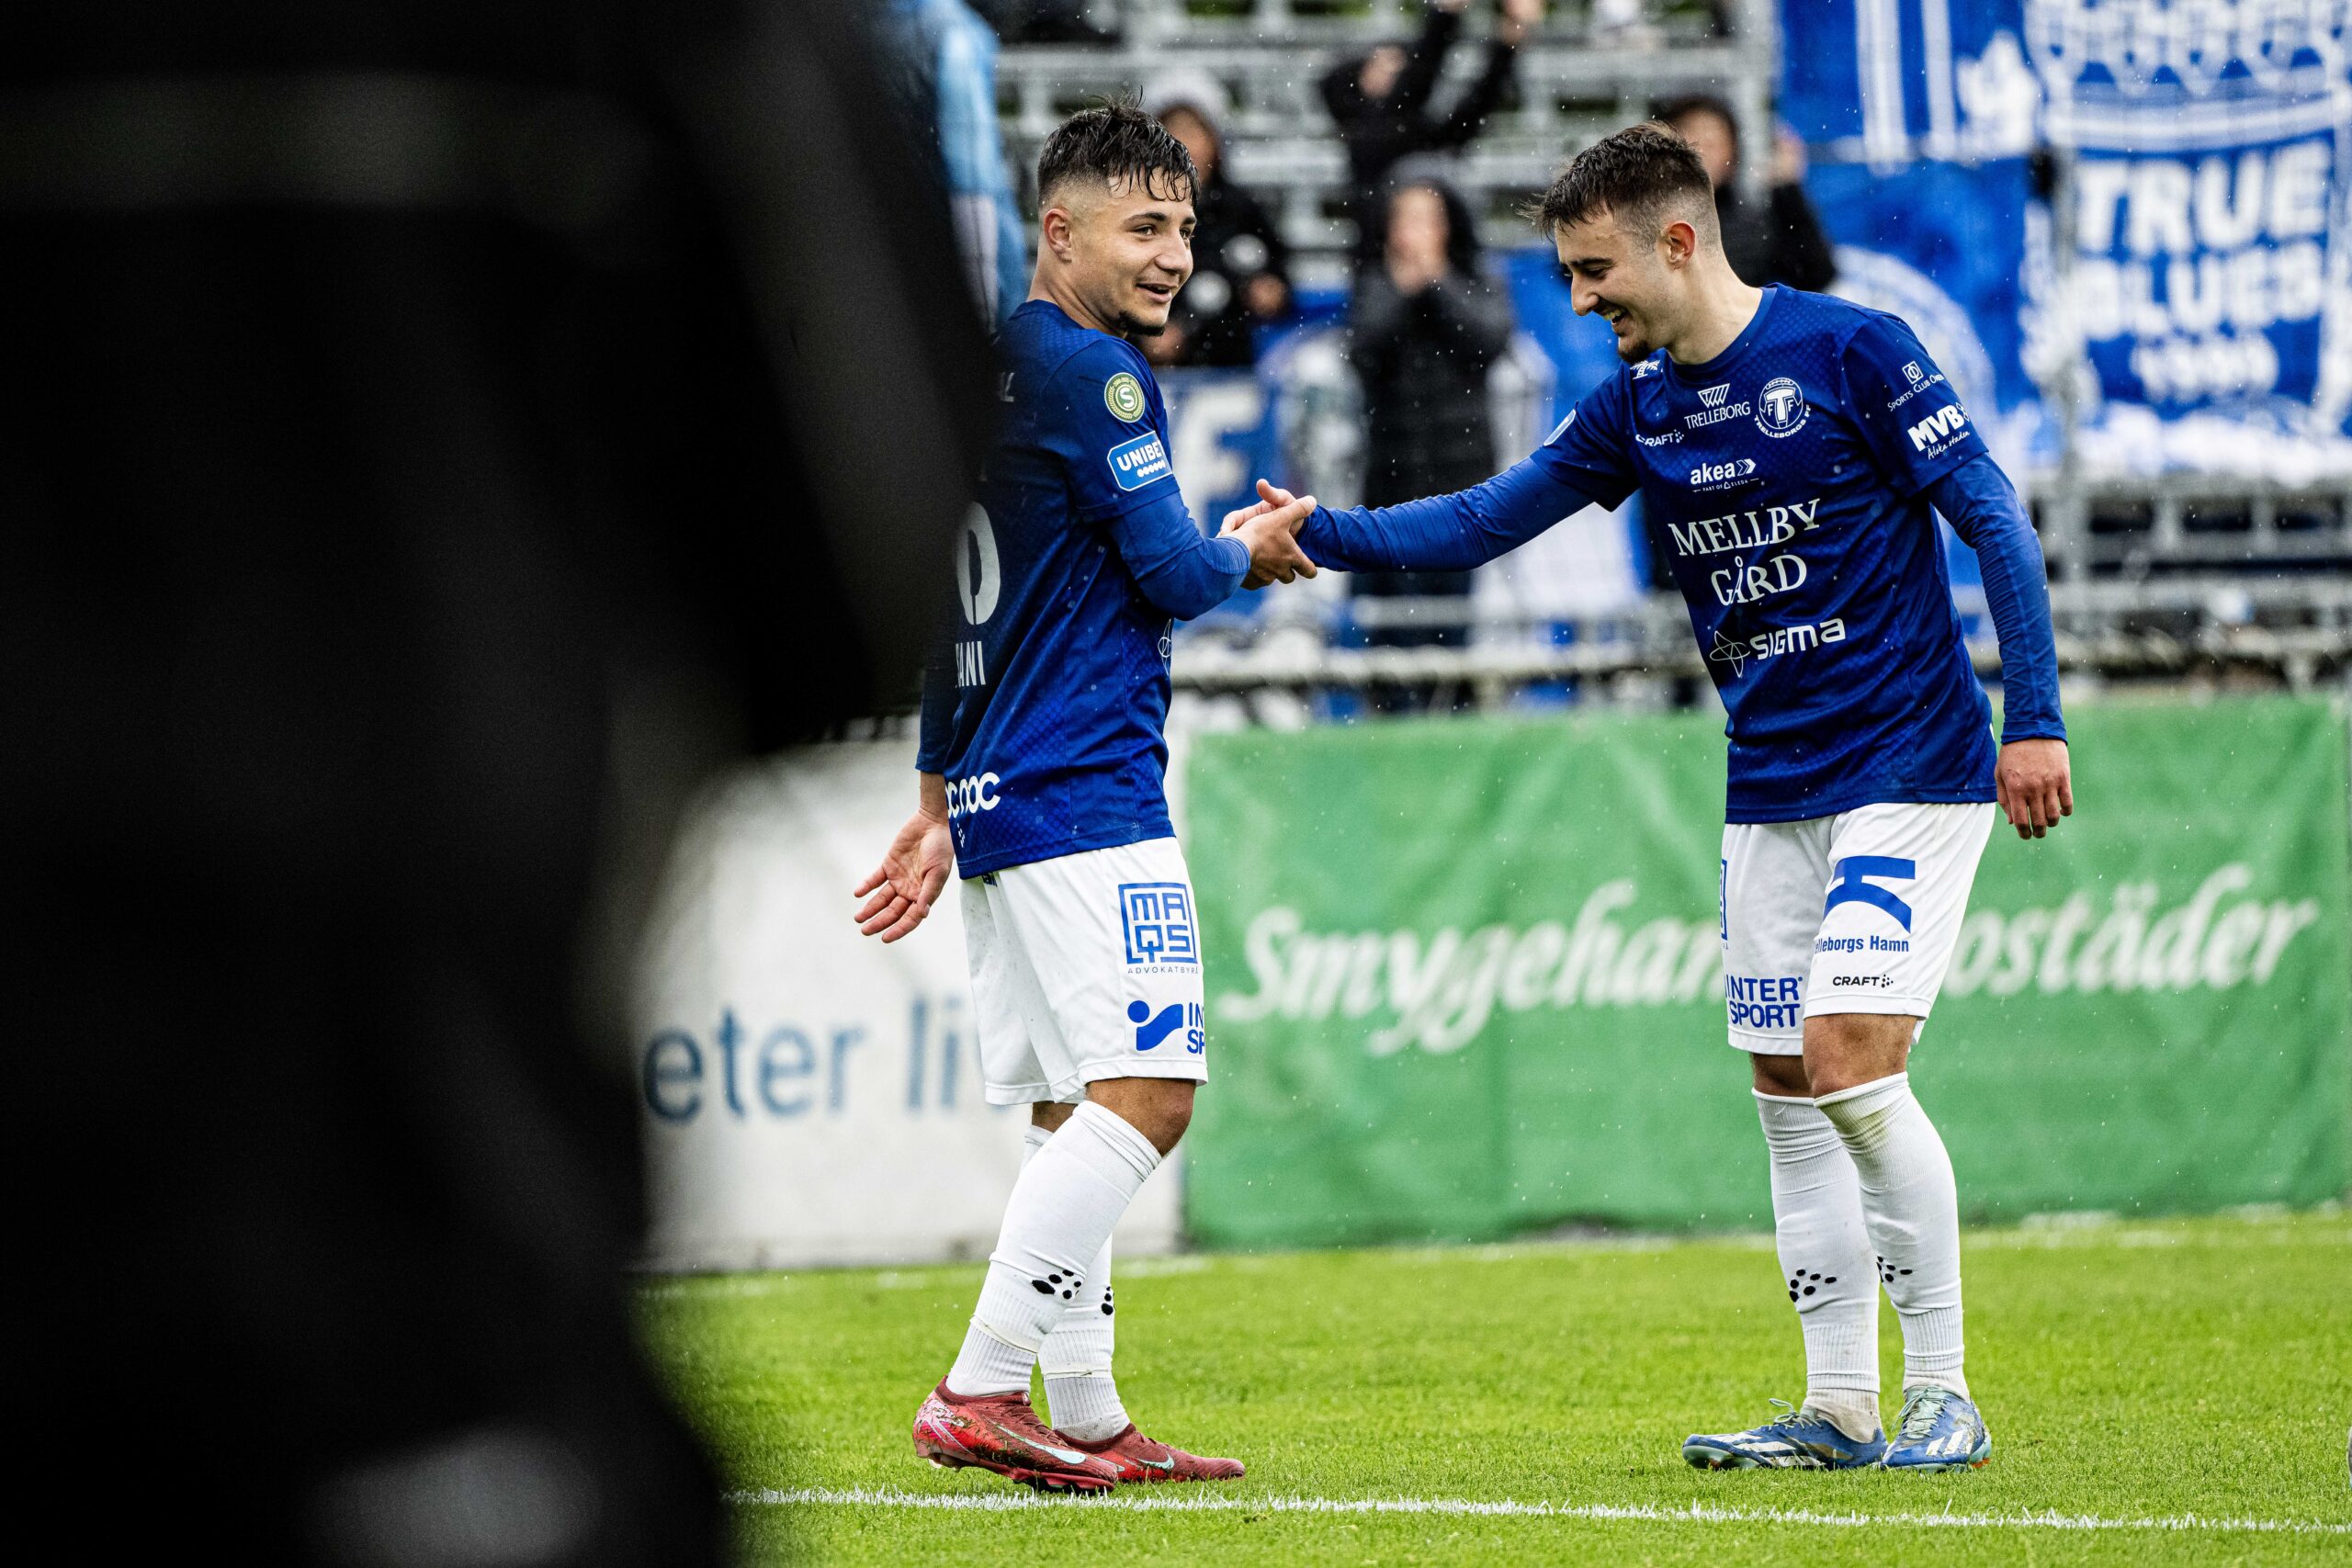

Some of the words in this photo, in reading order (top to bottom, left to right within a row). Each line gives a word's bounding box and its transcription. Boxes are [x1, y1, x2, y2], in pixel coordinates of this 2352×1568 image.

[2078, 141, 2329, 251] TRUE
[1684, 401, 1751, 429] TRELLEBORG
[1907, 405, 1964, 452] MVB
[1690, 462, 1736, 485] akea
[1668, 497, 1821, 557] MELLBY
[956, 502, 1001, 626] 0
[1711, 555, 1808, 606] GÅRD
[956, 640, 986, 688] ANI
[1869, 934, 1909, 953] Hamn
[1942, 863, 2317, 996] ostäder
[1726, 976, 1800, 1003] INTER
[1832, 976, 1881, 987] CRAFT
[1729, 1003, 1801, 1029] SPORT
[643, 1007, 865, 1126] eter
